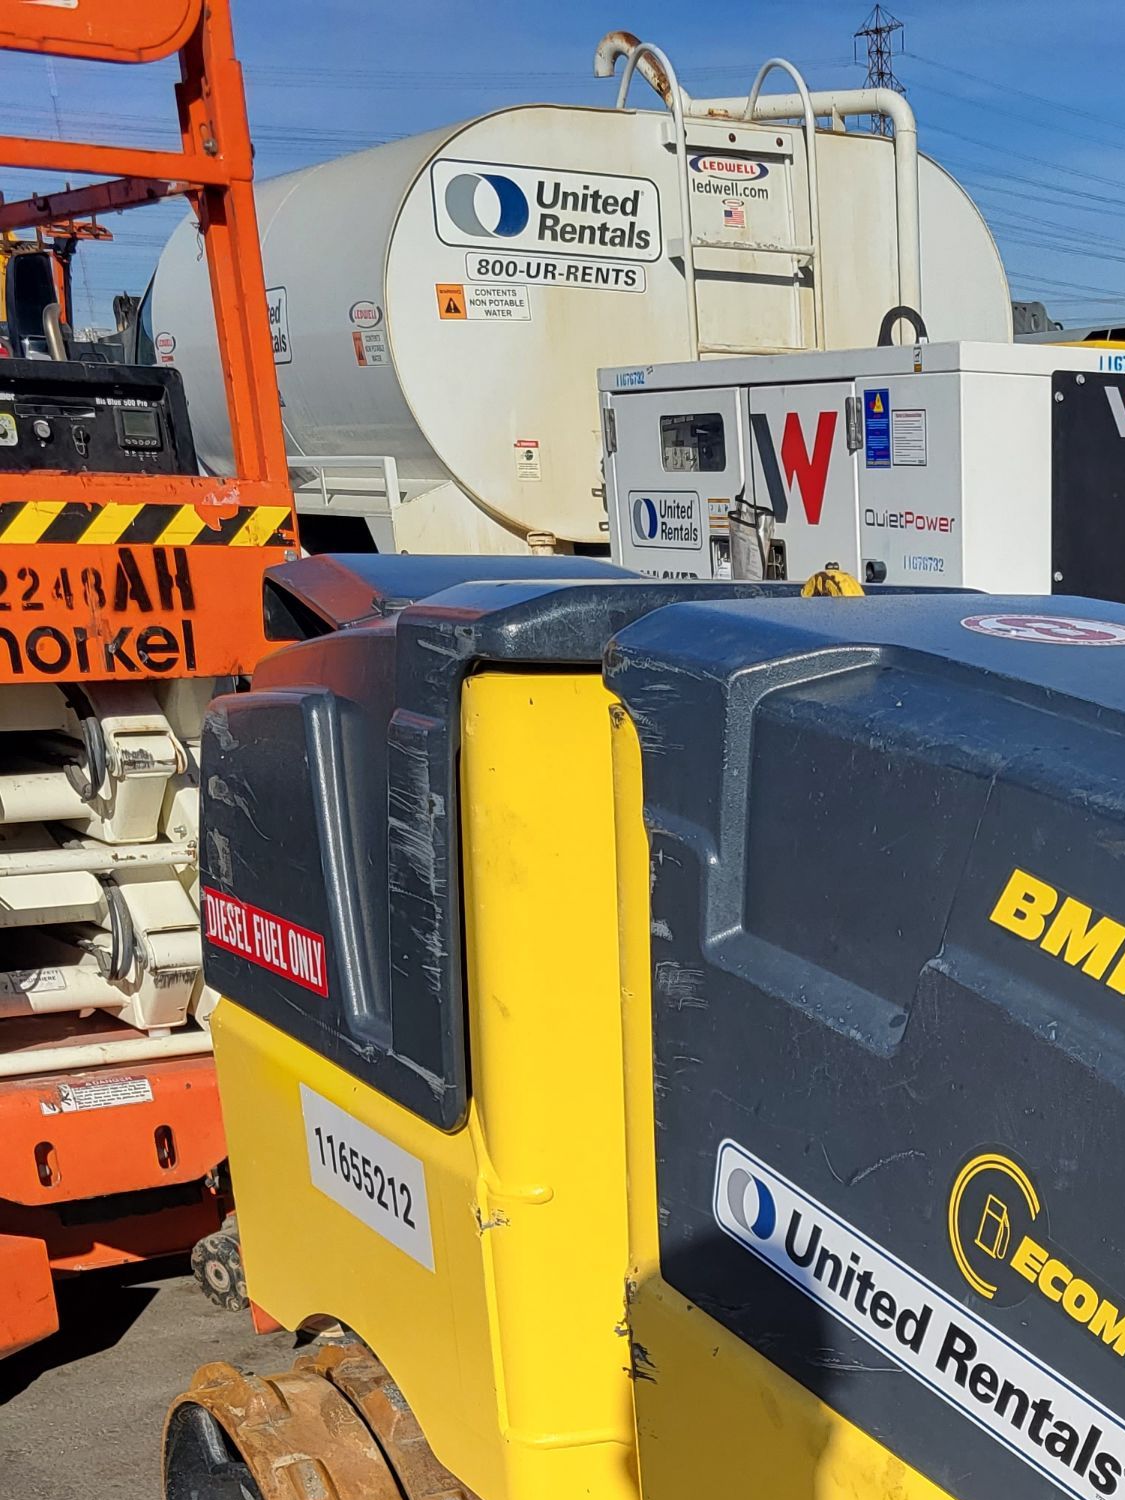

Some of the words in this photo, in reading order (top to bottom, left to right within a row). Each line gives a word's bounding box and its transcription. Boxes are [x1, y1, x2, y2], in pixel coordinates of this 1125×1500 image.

[703, 160, 756, 175] LEDWELL
[536, 181, 640, 217] United
[692, 178, 769, 199] ledwell.com
[538, 213, 651, 249] Rentals
[477, 259, 637, 286] 800-UR-RENTS
[470, 299, 486, 307] NON
[489, 299, 525, 307] POTABLE
[475, 288, 517, 297] CONTENTS
[484, 309, 512, 317] WATER
[659, 499, 693, 520] United
[865, 508, 955, 533] QuietPower
[660, 521, 698, 542] Rentals
[207, 893, 251, 953] DIESEL
[253, 915, 287, 971] FUEL
[288, 929, 323, 988] ONLY
[315, 1126, 416, 1230] 11655212
[785, 1210, 932, 1354] United
[935, 1323, 1122, 1496] Rentals
